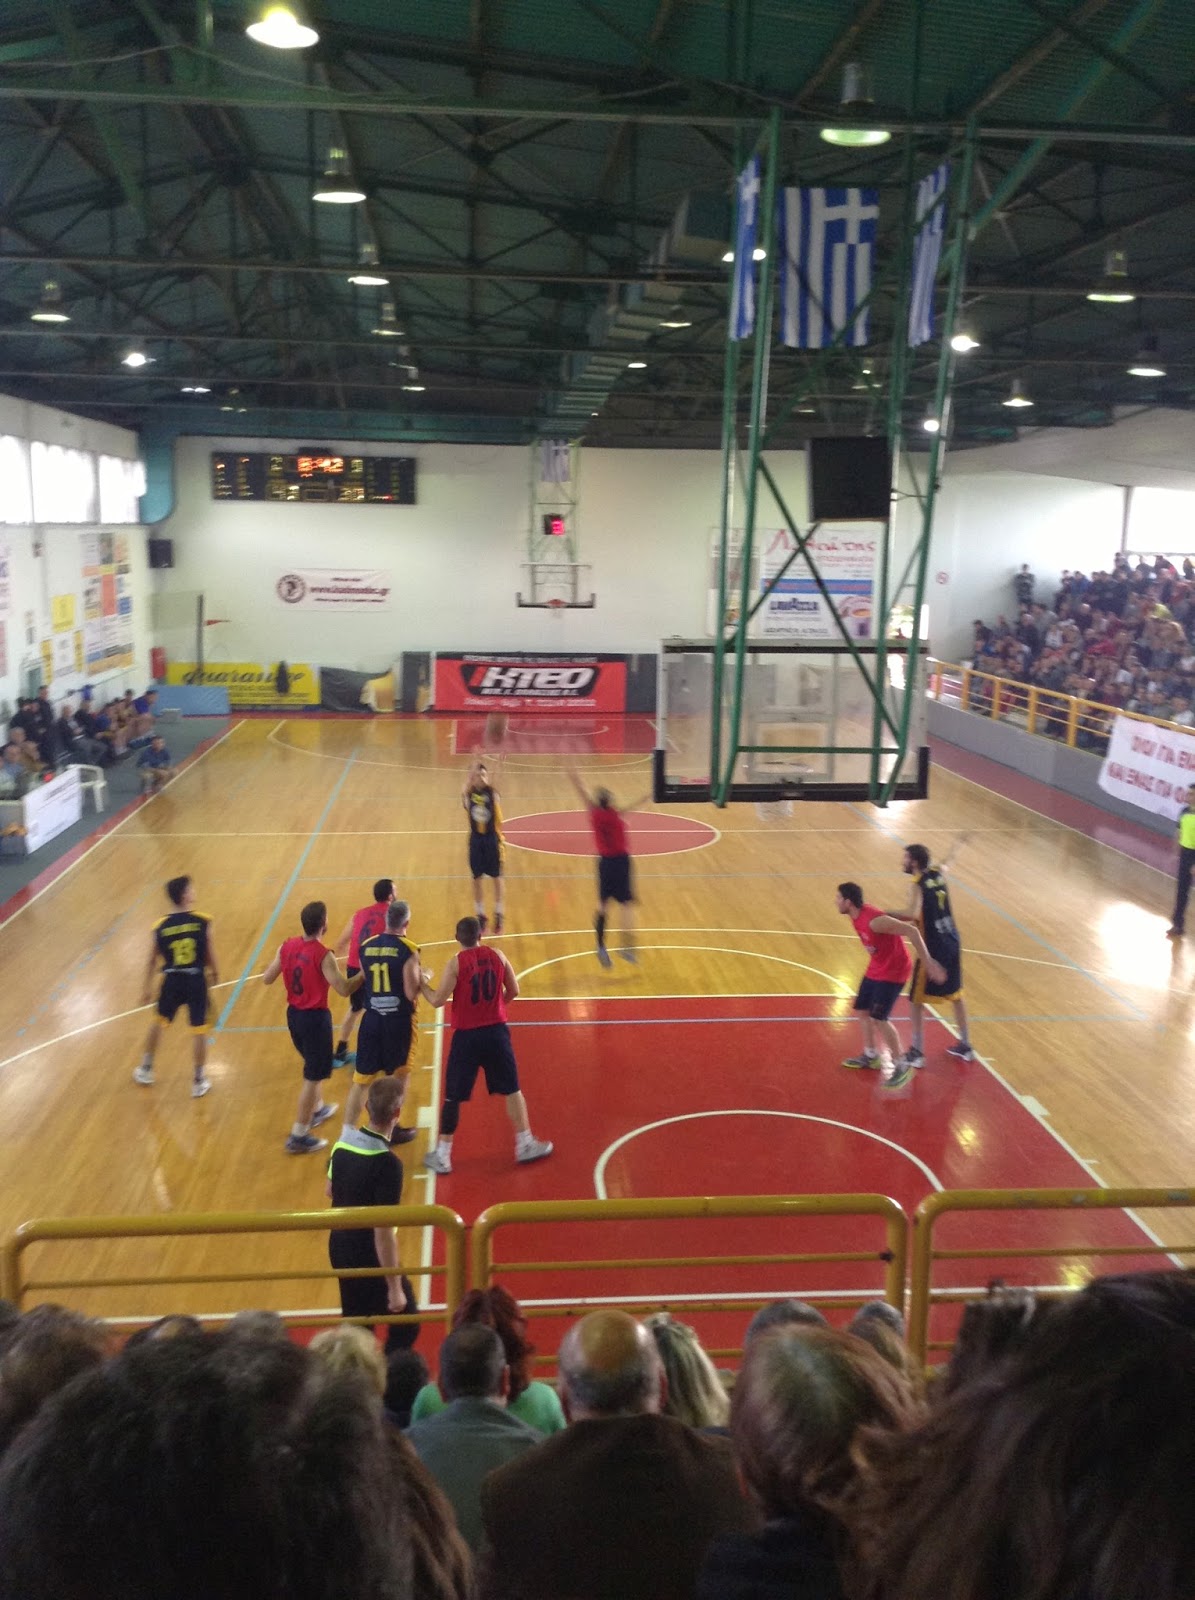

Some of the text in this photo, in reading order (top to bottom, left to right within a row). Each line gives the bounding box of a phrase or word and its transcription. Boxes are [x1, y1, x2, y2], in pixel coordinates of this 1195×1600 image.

[292, 966, 304, 996] 8
[369, 962, 392, 993] 11
[470, 969, 498, 1005] 10
